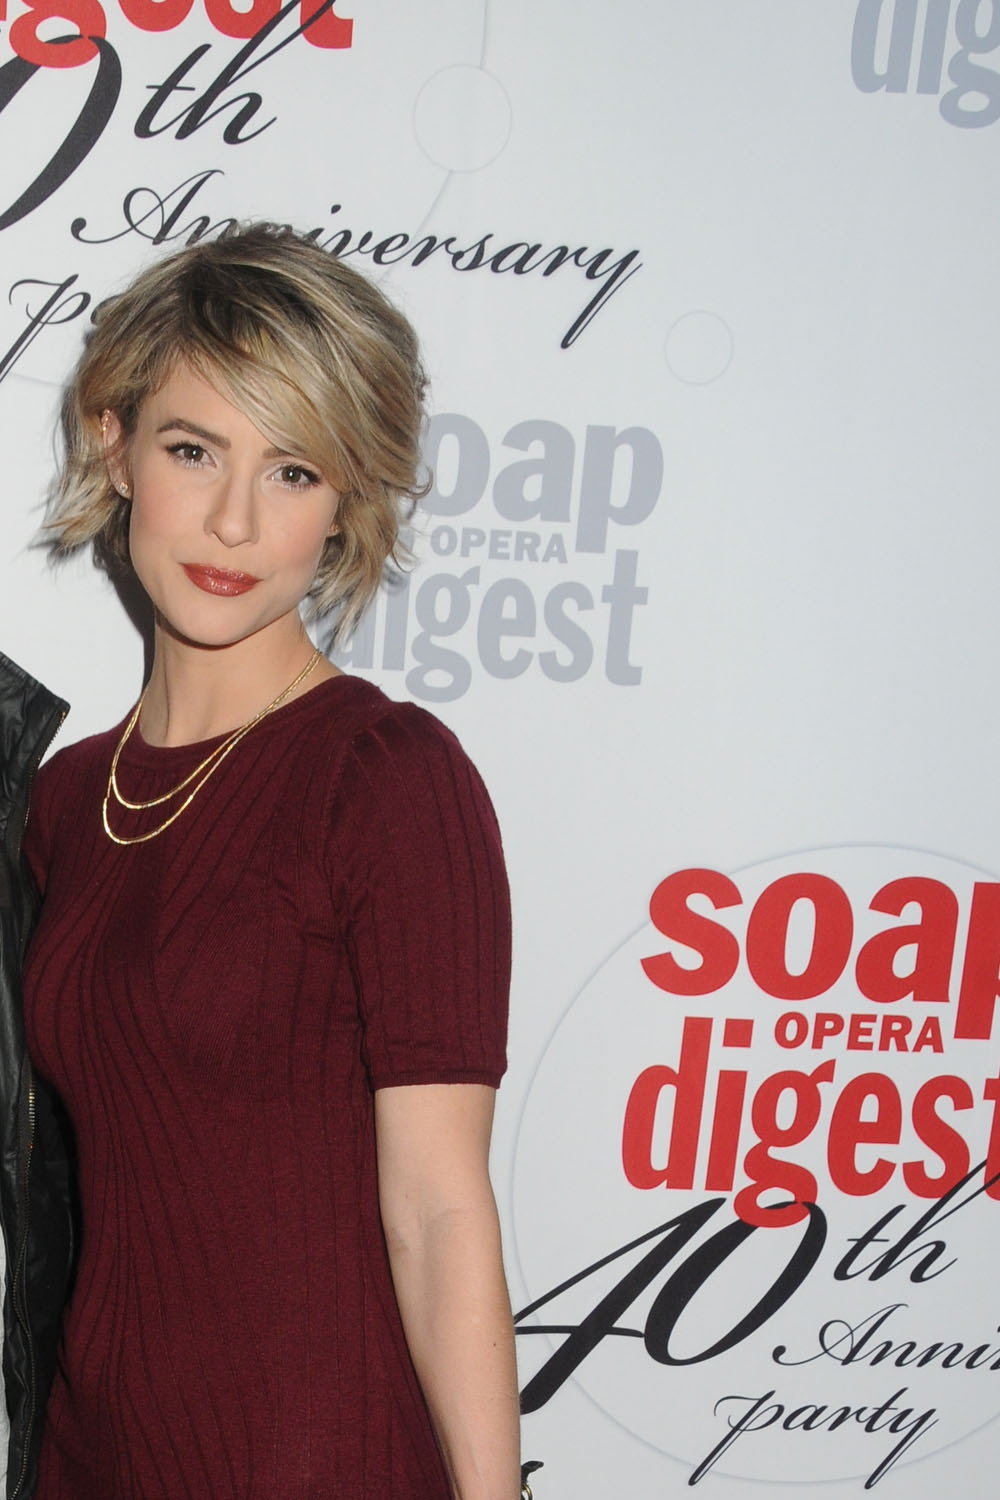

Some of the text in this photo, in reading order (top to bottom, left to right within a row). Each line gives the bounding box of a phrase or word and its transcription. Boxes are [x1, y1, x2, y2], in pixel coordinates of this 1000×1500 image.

[71, 170, 643, 349] Aniversary
[413, 412, 665, 553] oap
[430, 525, 568, 564] OPERA
[774, 1011, 944, 1054] OPERA
[514, 1156, 1000, 1416] 40th
[687, 1387, 938, 1490] party
